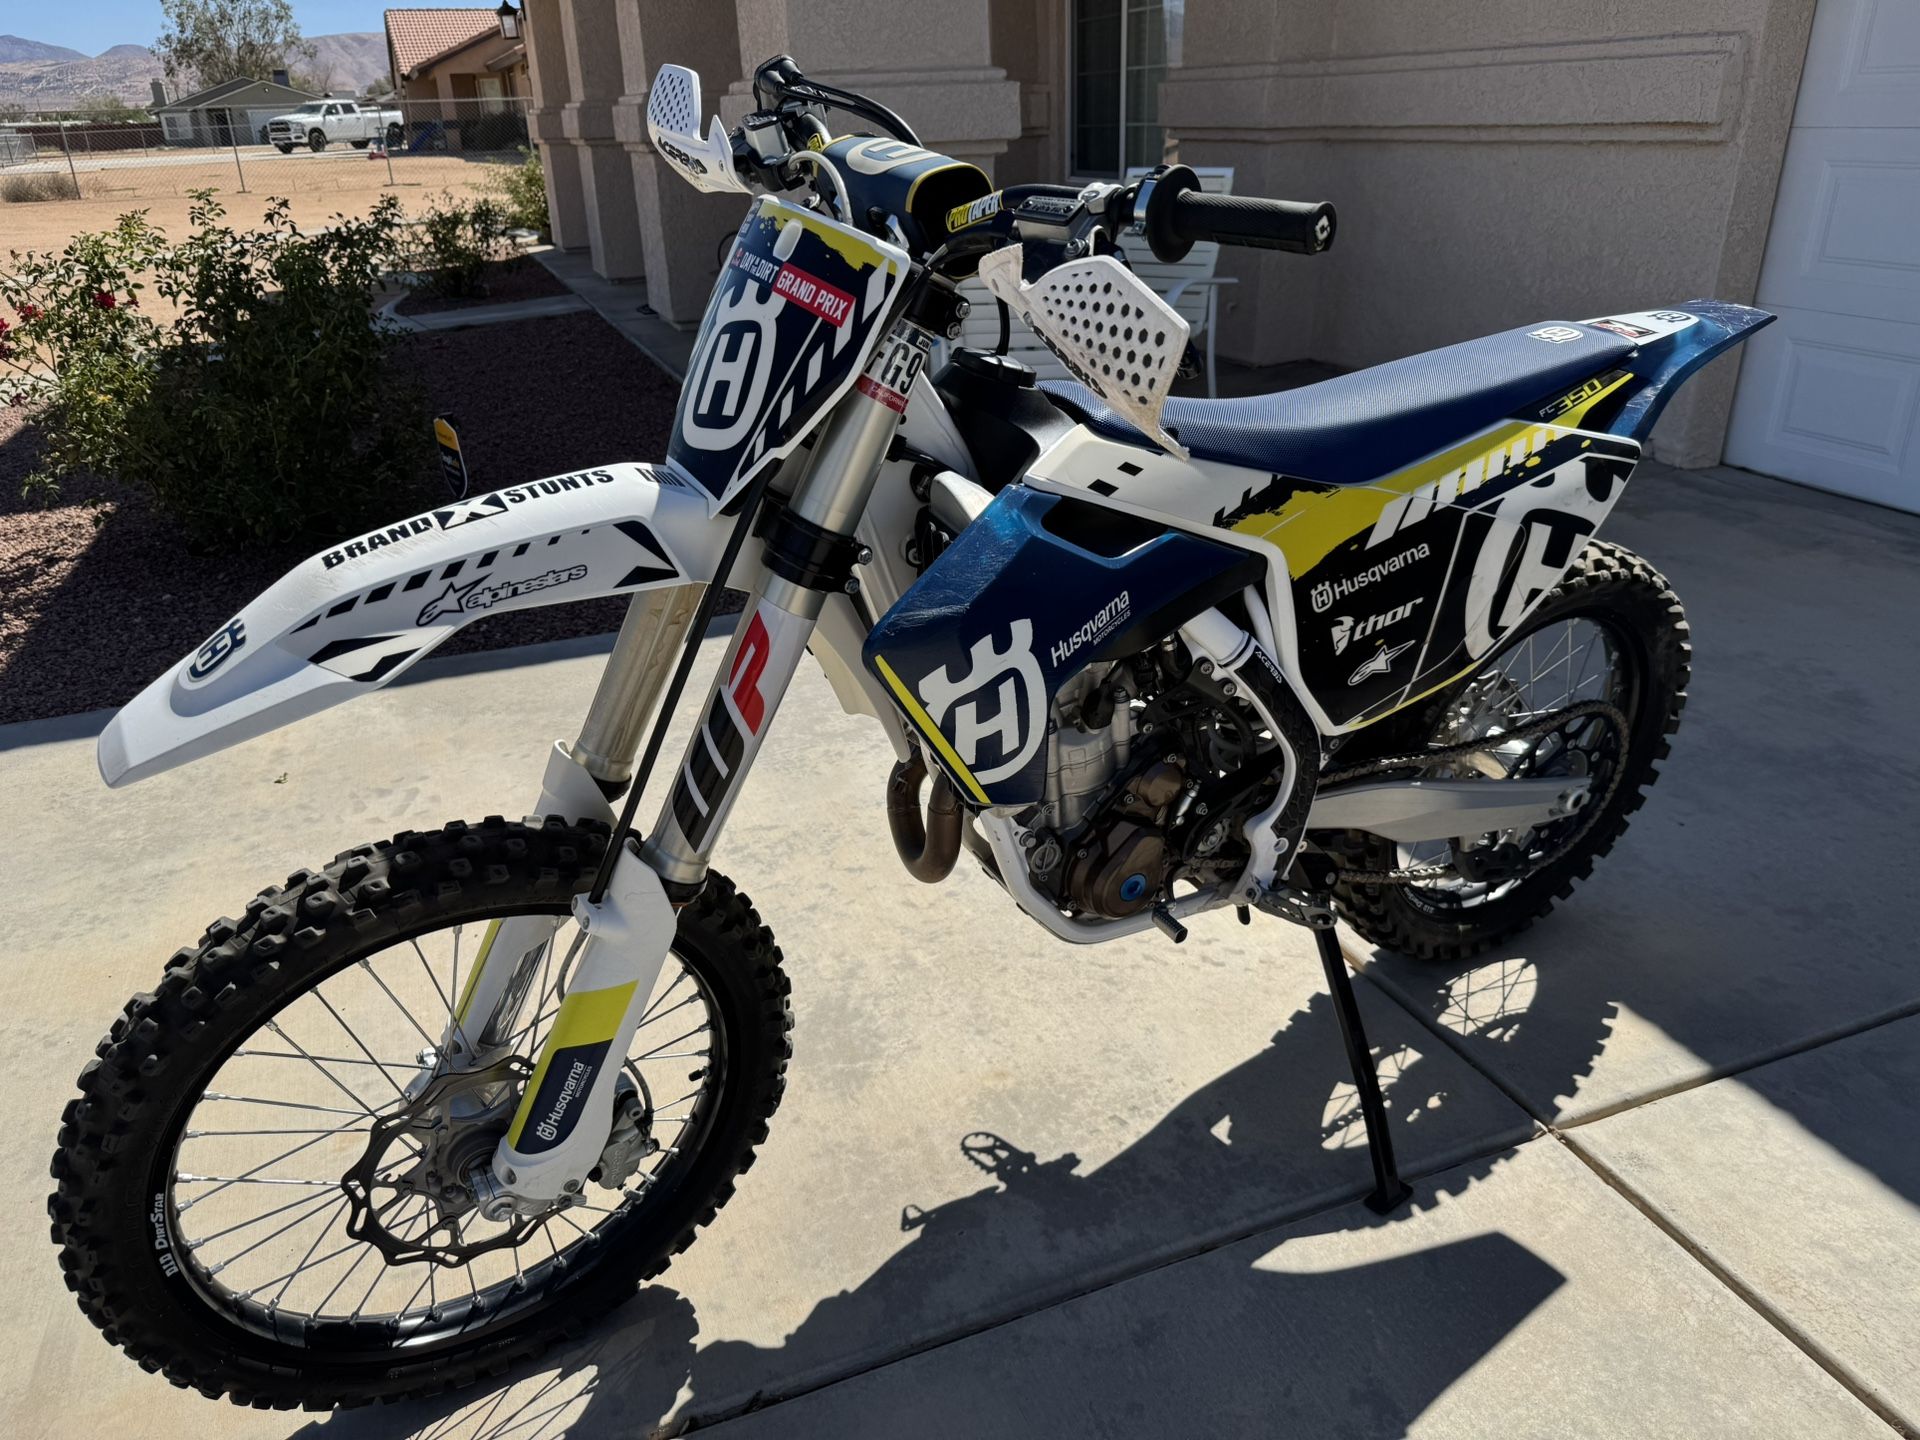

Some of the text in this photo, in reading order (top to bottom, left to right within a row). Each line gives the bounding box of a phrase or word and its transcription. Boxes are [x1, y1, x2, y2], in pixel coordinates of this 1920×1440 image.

[756, 259, 779, 283] DIRT
[777, 271, 847, 320] GRAND PRIX
[321, 516, 433, 570] BRAND
[504, 470, 614, 503] STUNTS
[466, 565, 588, 609] alpinestars
[1333, 543, 1430, 600] Husqvarna
[1051, 591, 1129, 668] Husqvarna
[1093, 610, 1131, 646] MOTORCYCLES
[1353, 597, 1424, 641] thor
[546, 1062, 585, 1126] Husqvarna
[159, 1253, 179, 1277] DID
